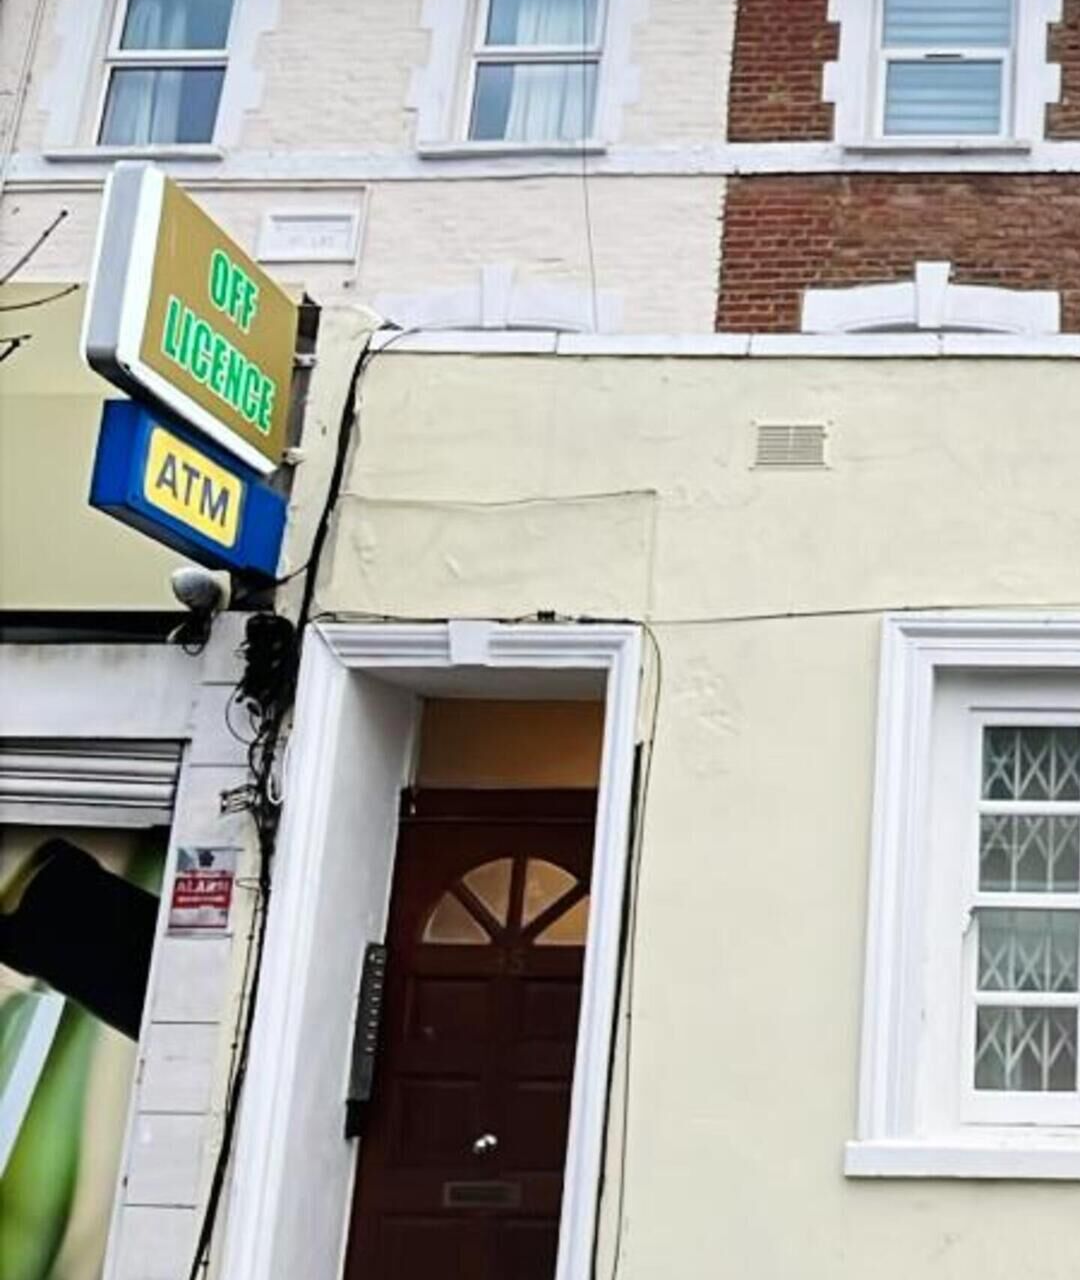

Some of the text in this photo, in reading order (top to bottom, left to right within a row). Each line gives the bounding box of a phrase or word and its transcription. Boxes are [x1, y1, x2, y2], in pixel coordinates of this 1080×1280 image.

[209, 249, 259, 333] OFF
[162, 295, 275, 434] LICENCE
[155, 454, 230, 527] ATM
